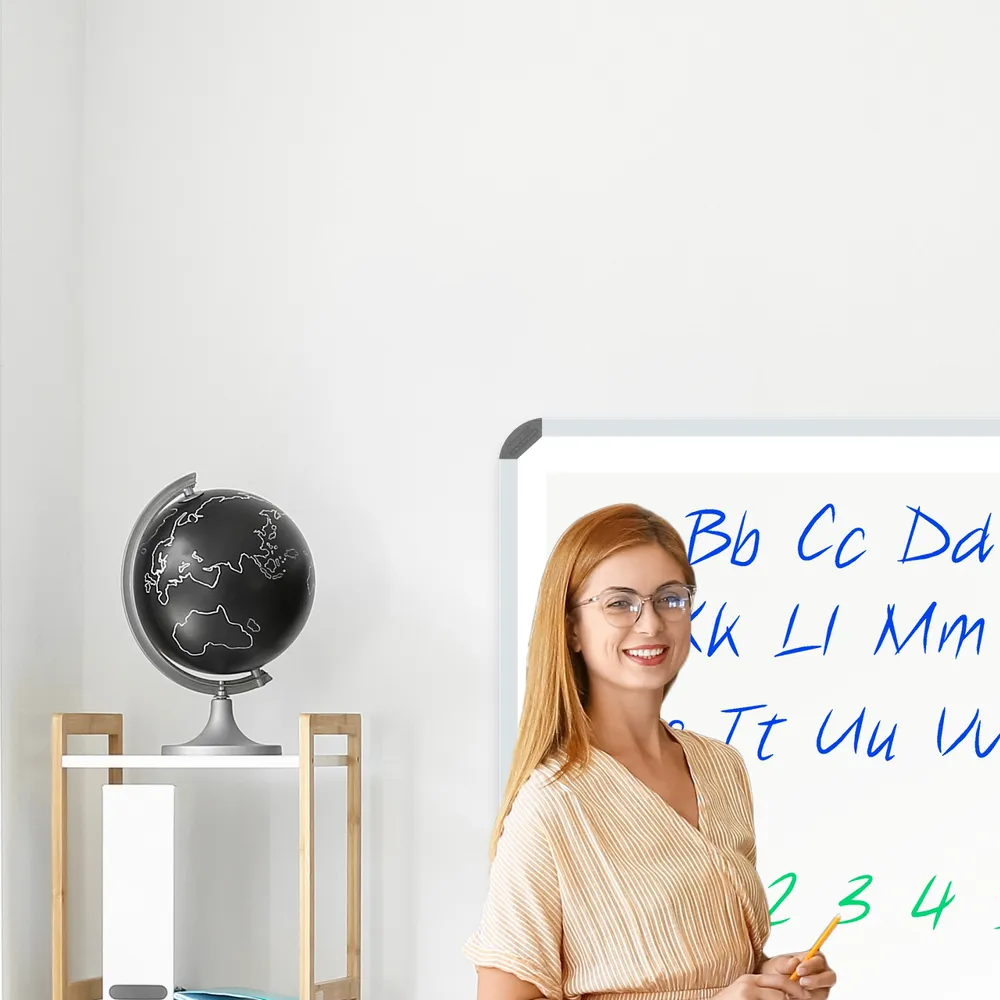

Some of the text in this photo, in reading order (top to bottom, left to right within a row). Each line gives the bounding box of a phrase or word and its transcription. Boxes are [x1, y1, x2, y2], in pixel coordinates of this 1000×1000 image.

[685, 508, 760, 567] Bb
[797, 503, 866, 569] Cc
[897, 505, 994, 564] Dd
[774, 603, 840, 658] Ll
[873, 600, 986, 659] Mm
[720, 703, 788, 762] Tt
[815, 706, 899, 762] Uu
[768, 872, 798, 927] 2
[837, 874, 874, 925] 3
[910, 874, 956, 930] 4
